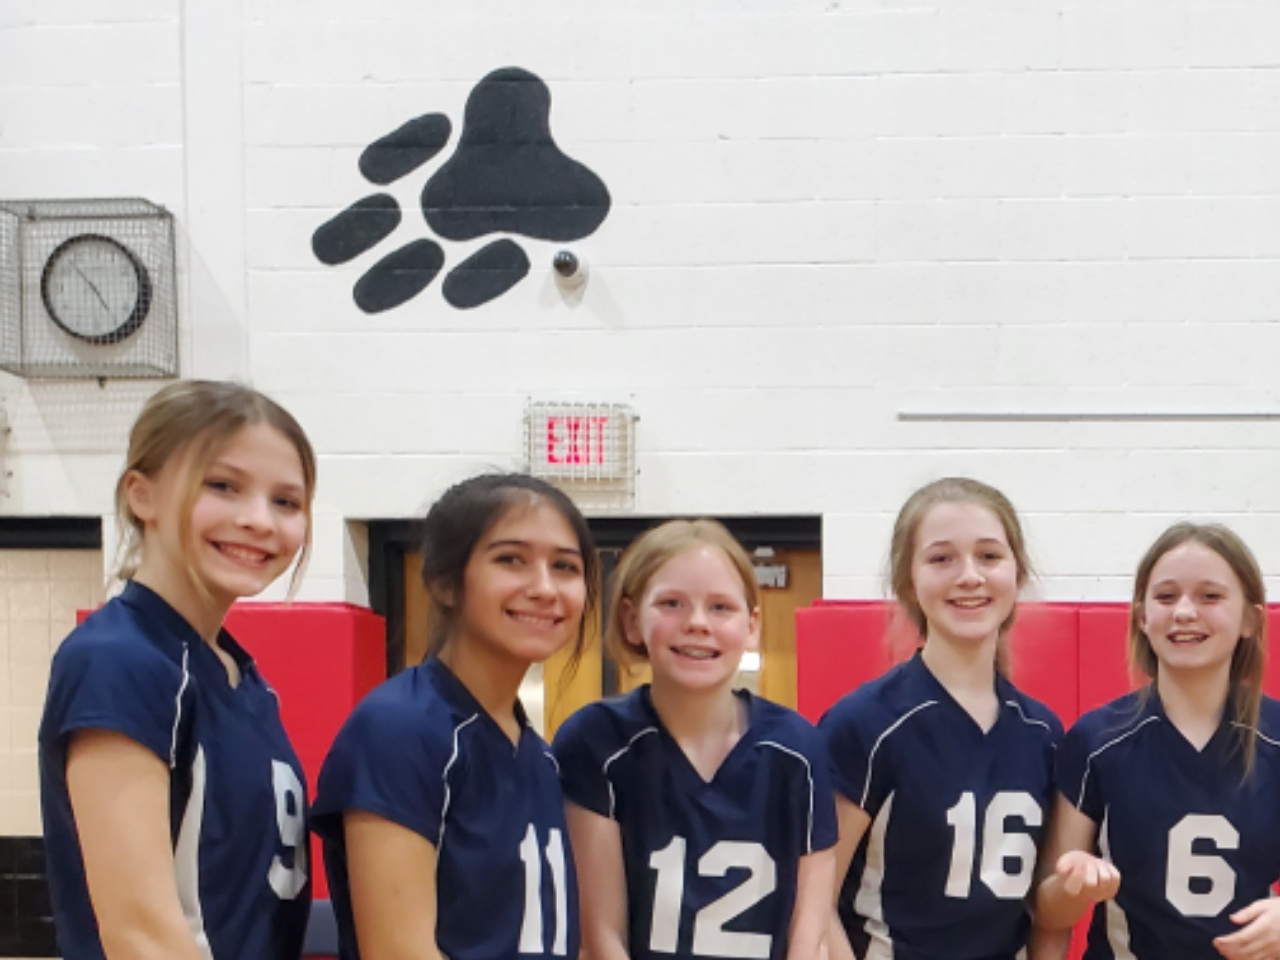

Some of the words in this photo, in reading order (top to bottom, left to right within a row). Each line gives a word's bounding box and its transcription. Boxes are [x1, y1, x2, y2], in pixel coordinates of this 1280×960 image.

[546, 415, 608, 465] EXIT
[267, 759, 308, 900] 9
[944, 791, 1043, 899] 16
[1165, 813, 1240, 918] 6
[518, 823, 567, 956] 11
[648, 835, 777, 959] 12
